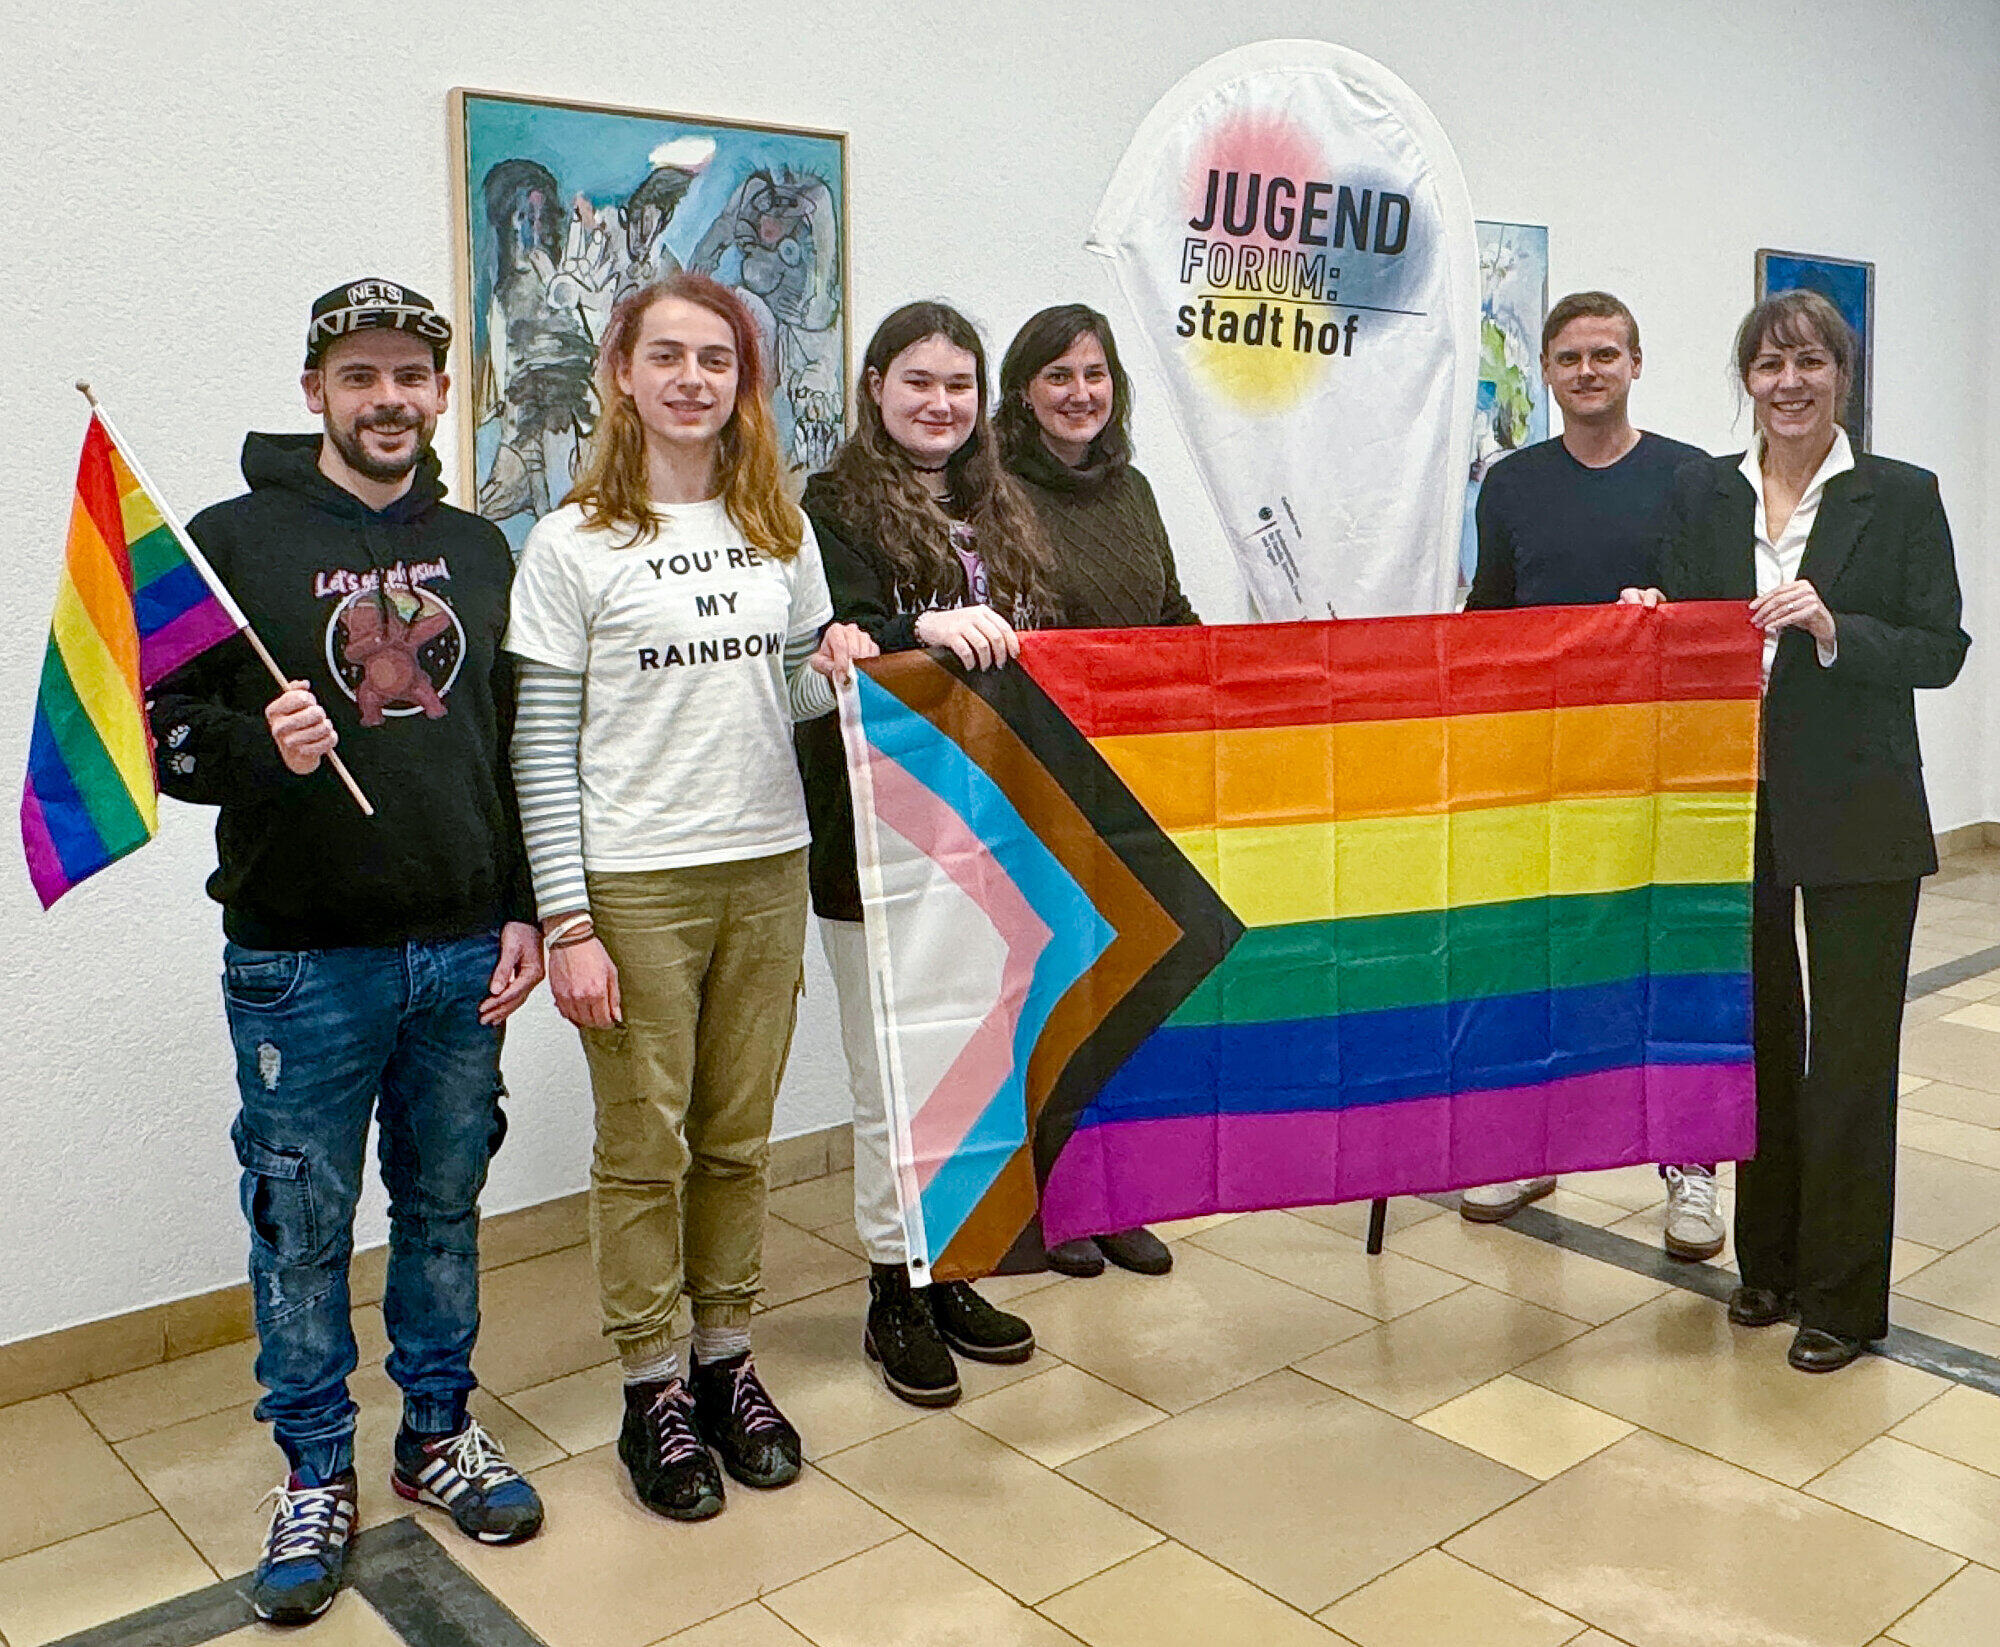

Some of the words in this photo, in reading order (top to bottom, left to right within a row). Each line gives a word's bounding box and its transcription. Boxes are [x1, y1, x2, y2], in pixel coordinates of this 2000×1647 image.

[1188, 168, 1411, 256] JUGEND
[1180, 237, 1342, 302] FORUM:
[351, 284, 400, 301] NETS
[309, 309, 451, 344] NETS
[646, 547, 763, 580] YOU'RE
[695, 591, 739, 618] MY
[638, 632, 784, 671] RAINBOW
